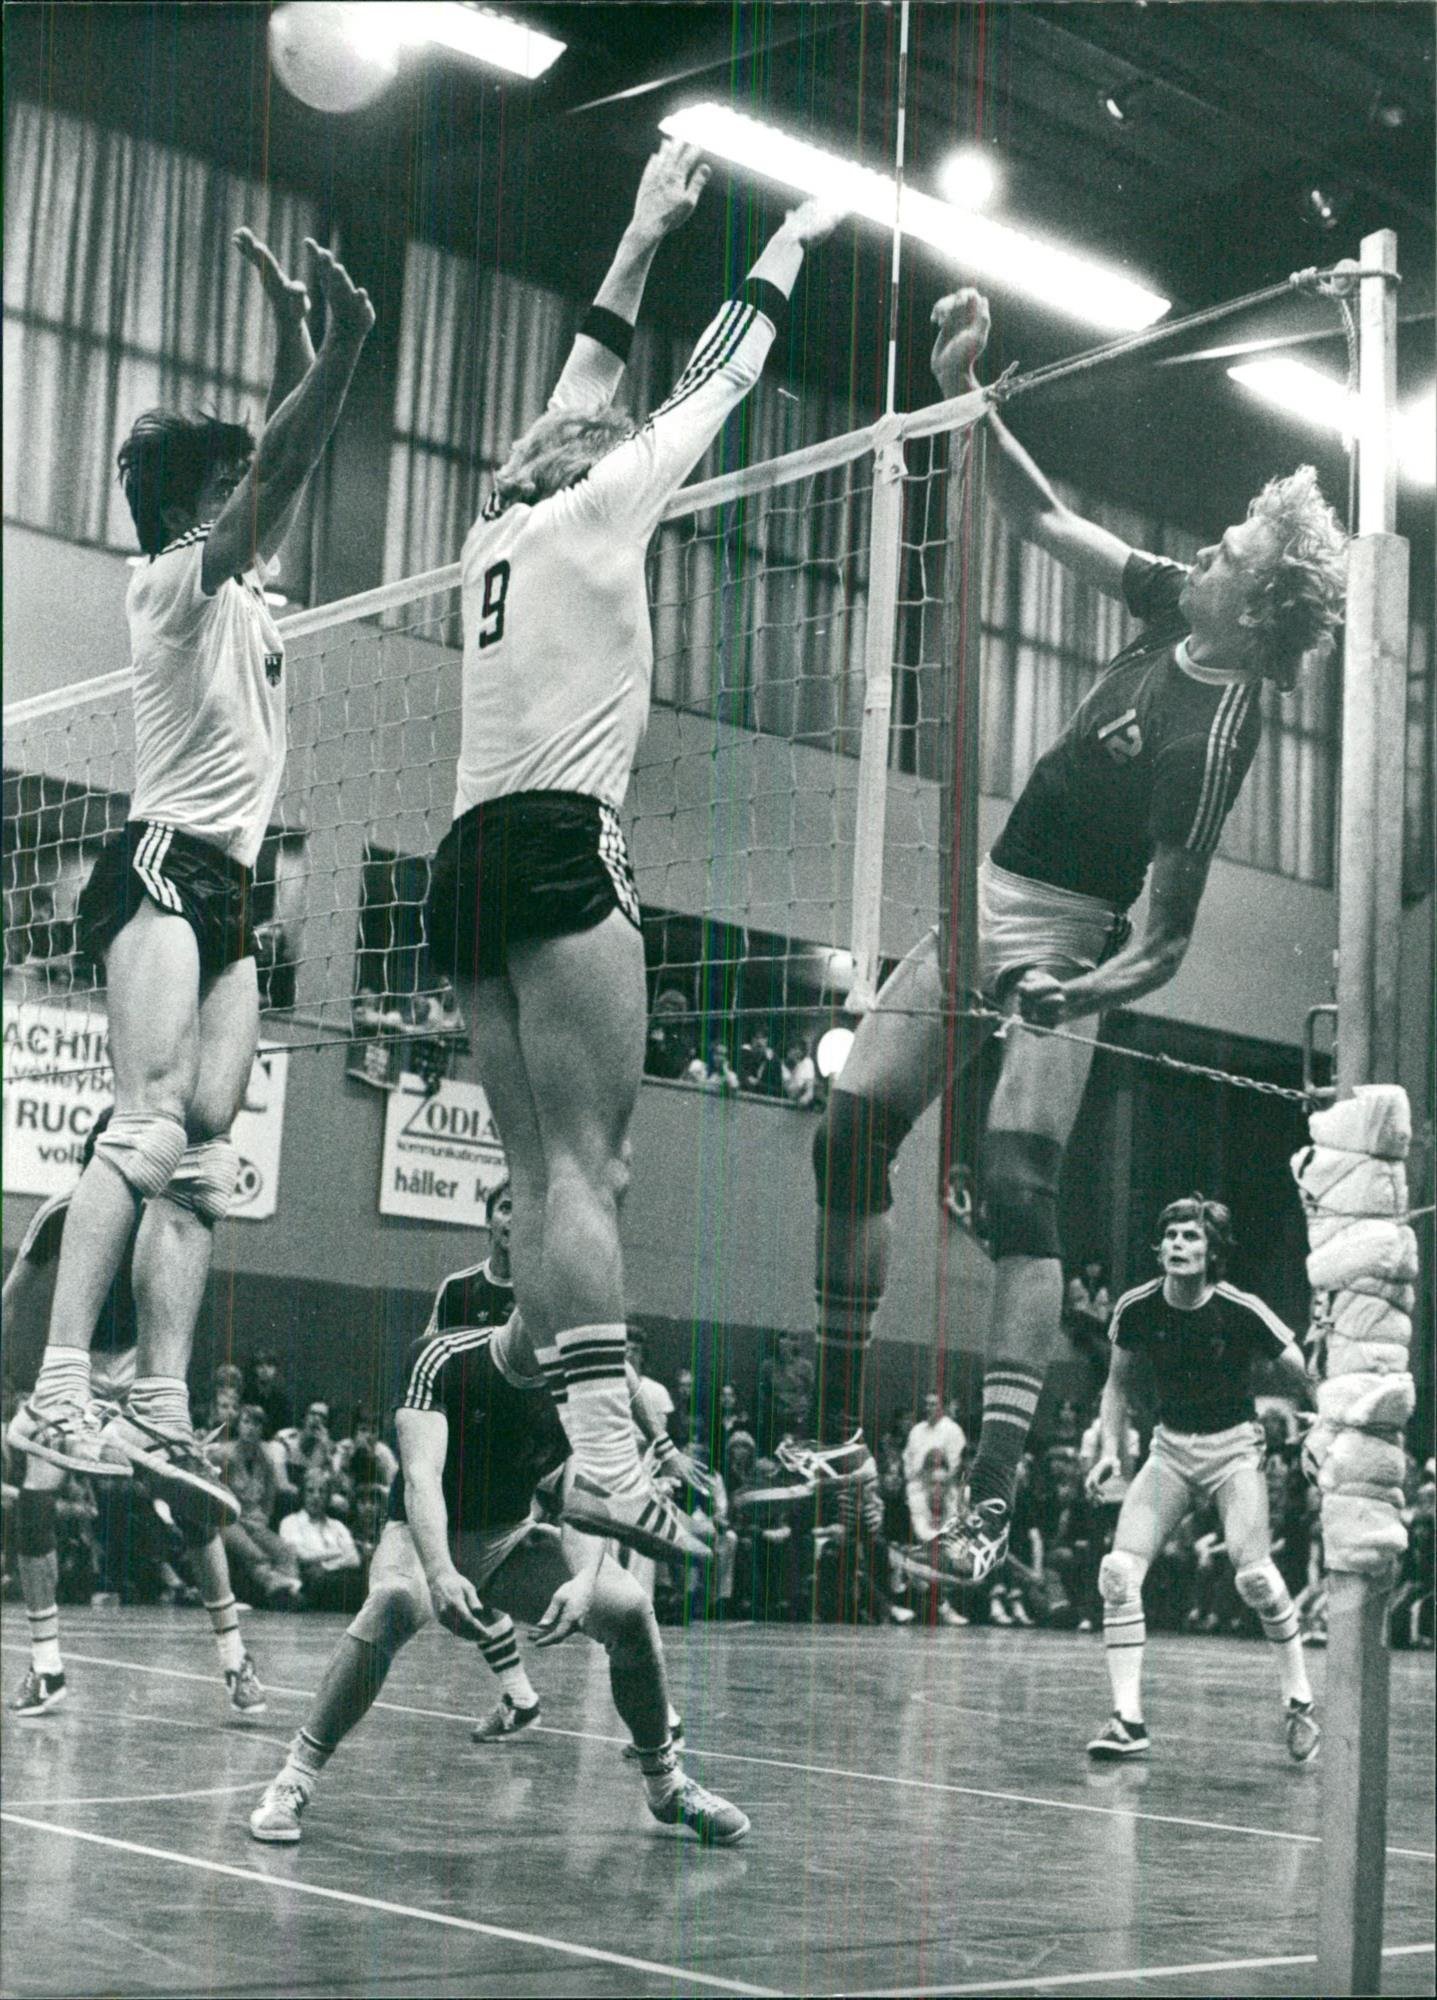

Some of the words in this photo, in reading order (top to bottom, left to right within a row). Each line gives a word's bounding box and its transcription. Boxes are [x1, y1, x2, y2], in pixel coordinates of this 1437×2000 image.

[479, 558, 511, 649] 9
[17, 1098, 92, 1135] RUC
[395, 1166, 459, 1198] håller
